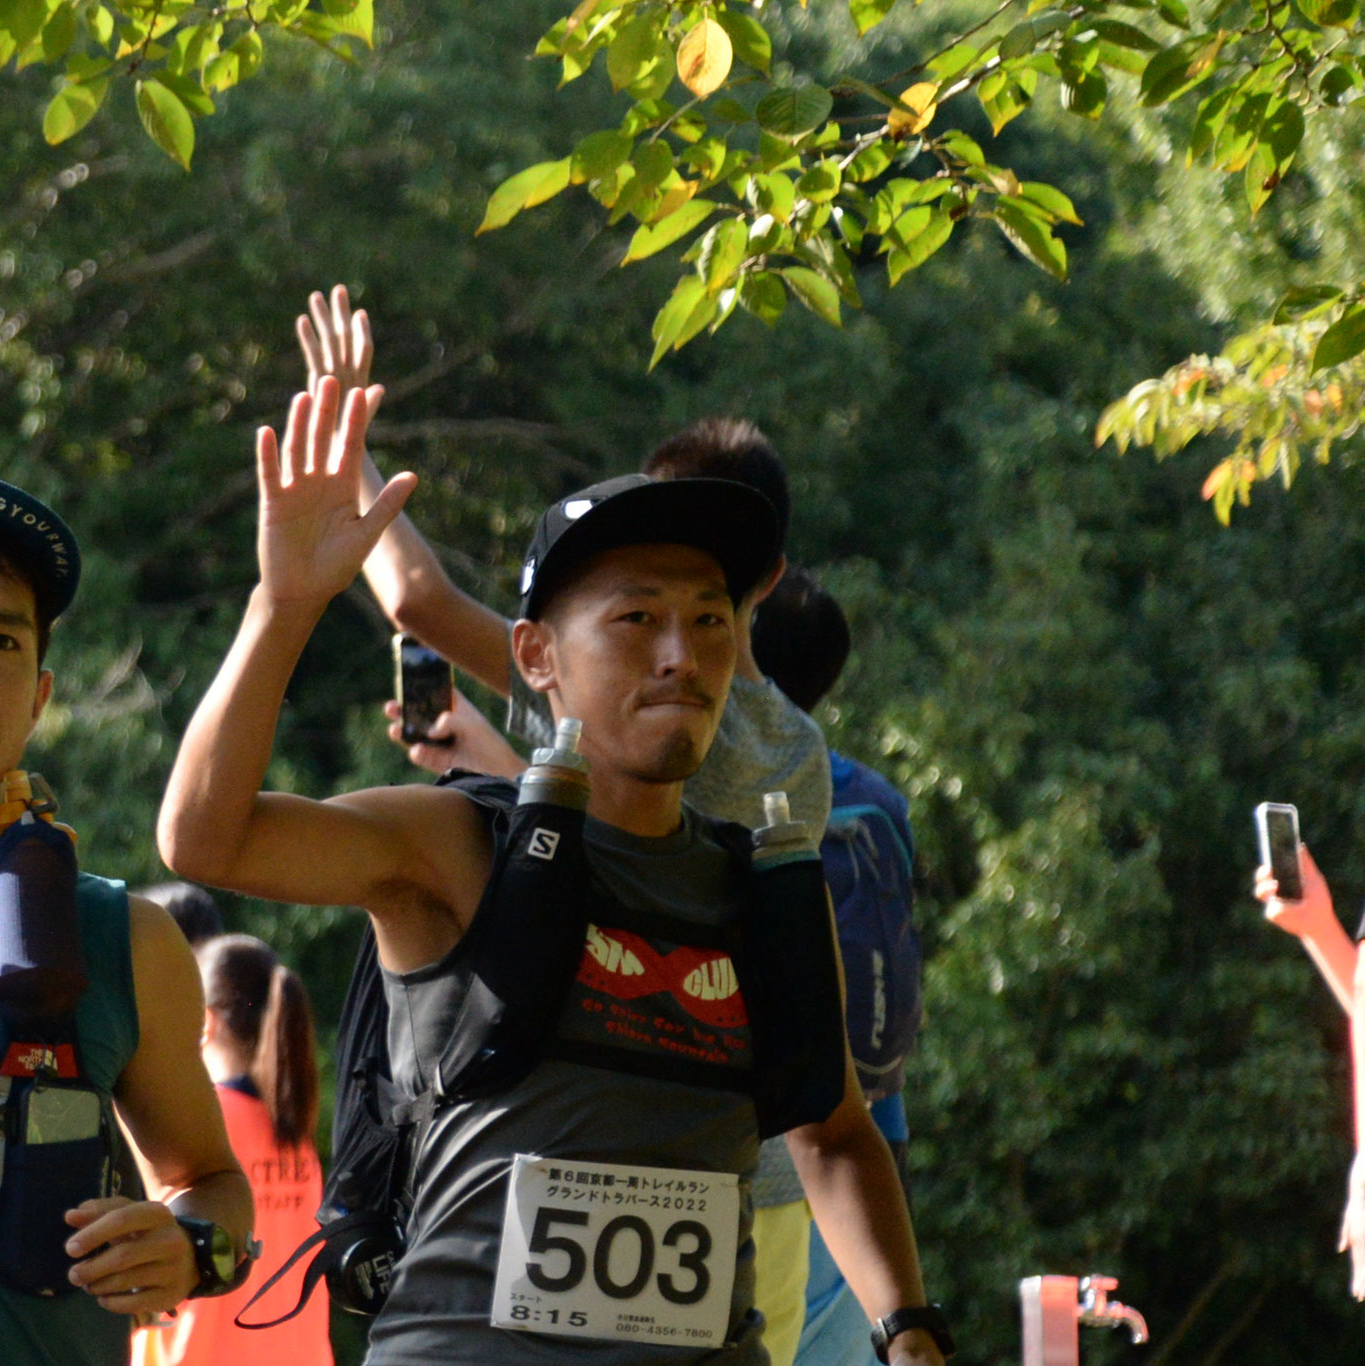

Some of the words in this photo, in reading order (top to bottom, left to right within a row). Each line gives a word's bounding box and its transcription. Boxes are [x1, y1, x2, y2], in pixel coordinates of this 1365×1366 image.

[548, 1168, 710, 1194] 第6回京都一周トレイルラン
[546, 1186, 707, 1212] グランドトラバース2022
[525, 1206, 712, 1305] 503
[510, 1292, 543, 1304] スタート
[510, 1305, 589, 1327] 8:15
[615, 1322, 713, 1339] 080-4356-7800
